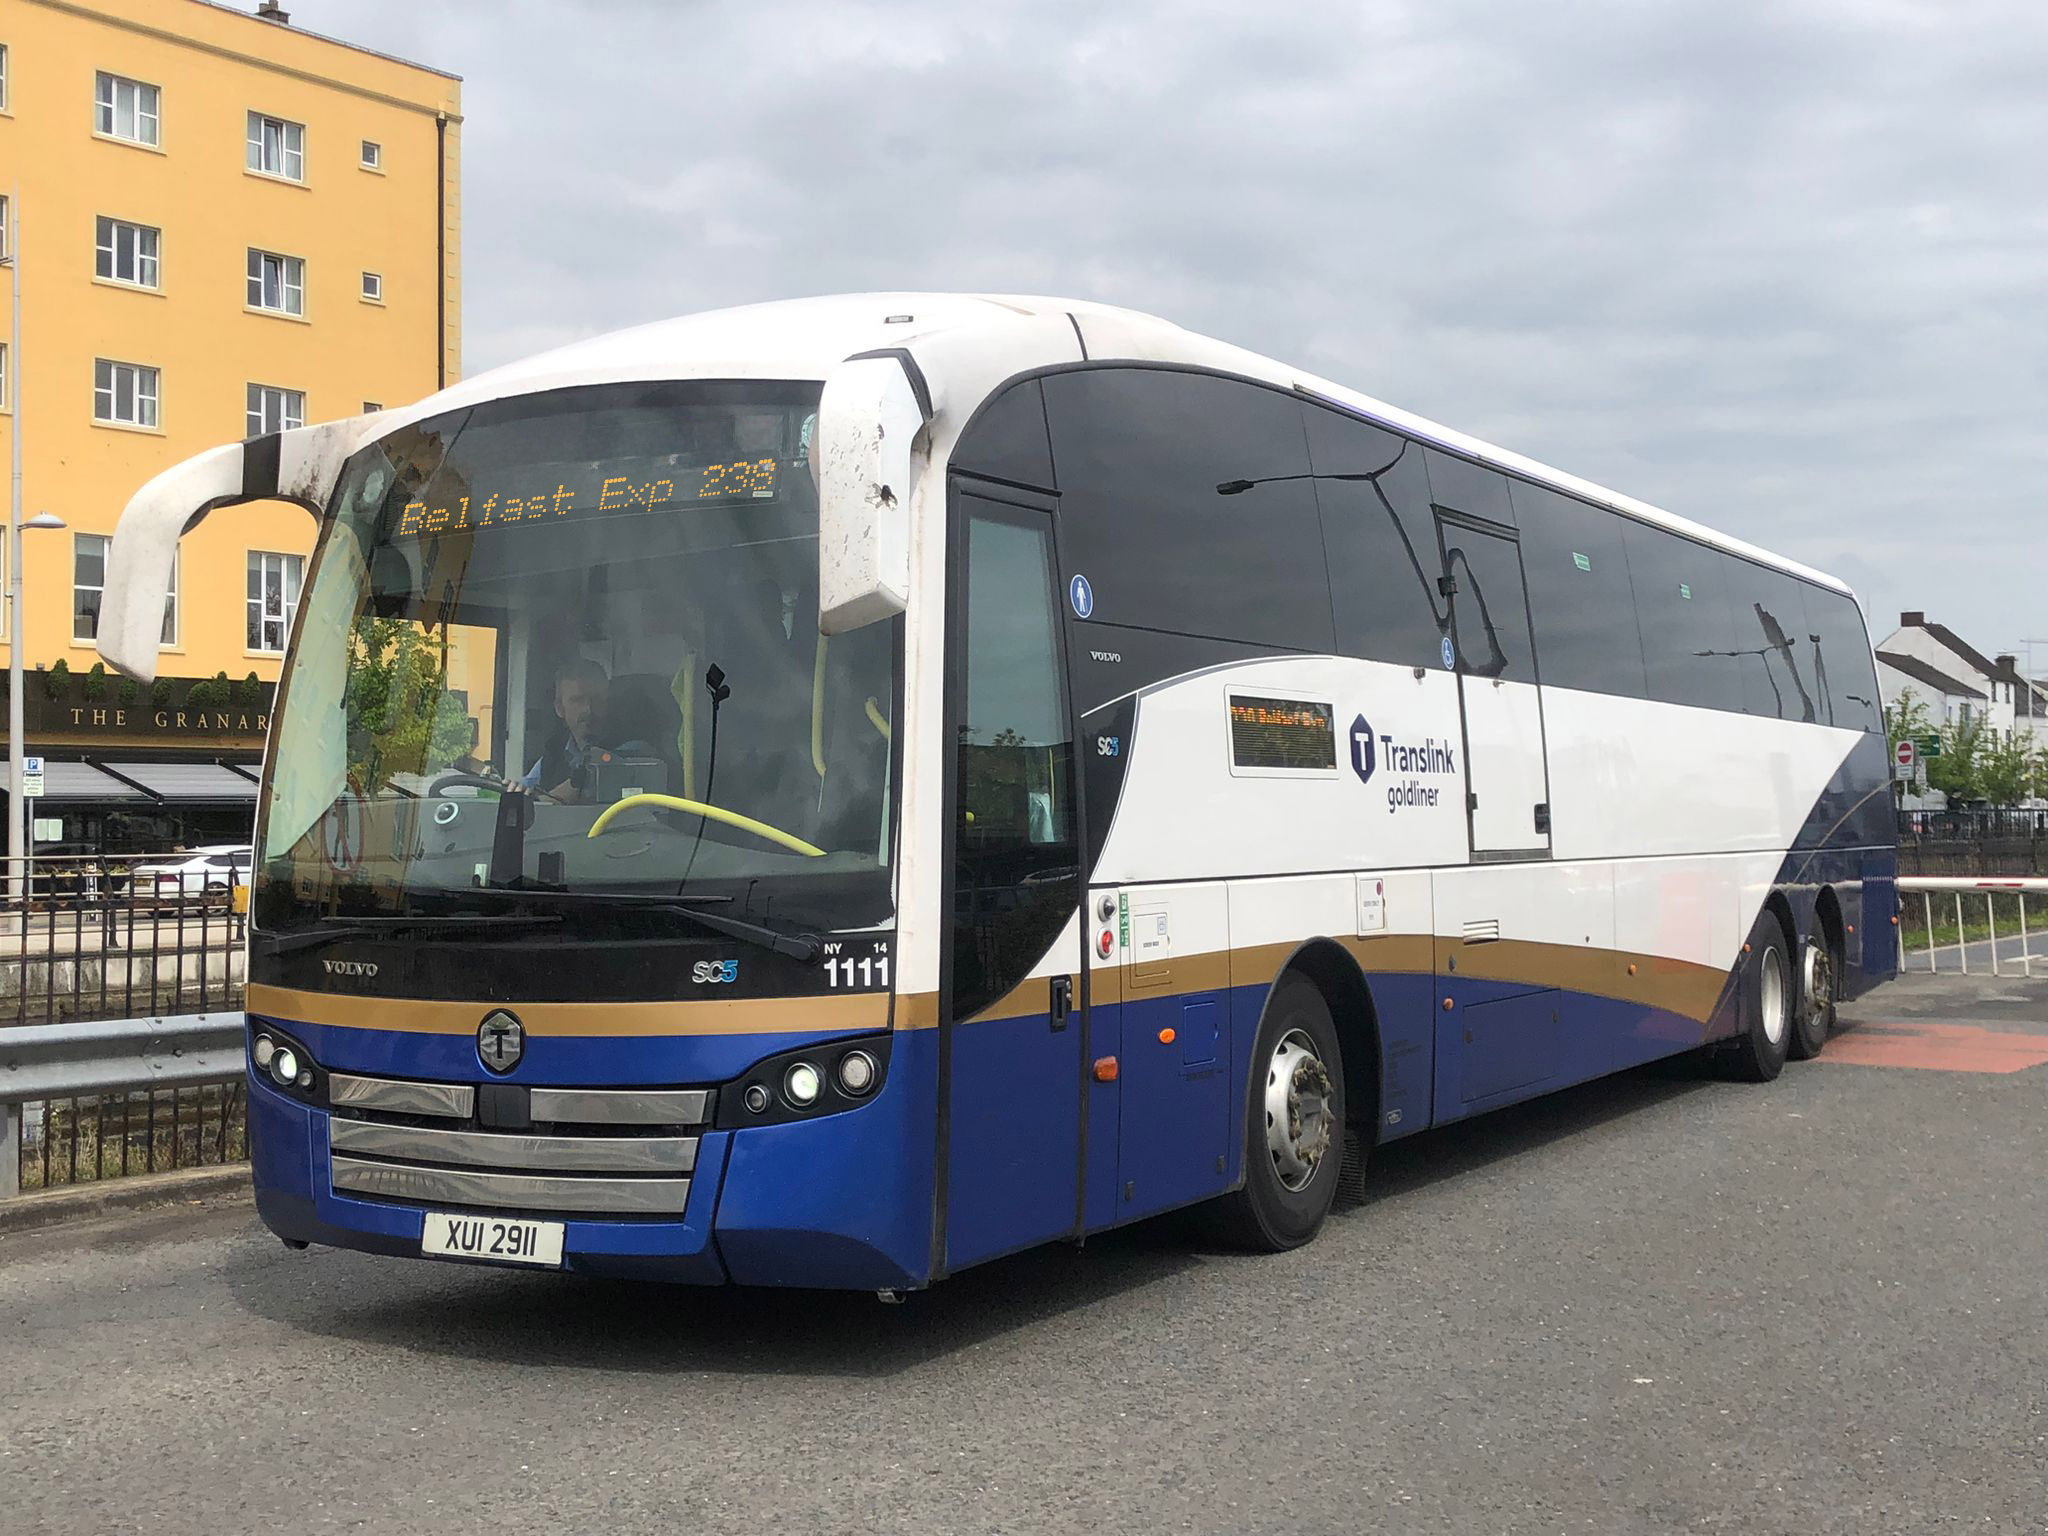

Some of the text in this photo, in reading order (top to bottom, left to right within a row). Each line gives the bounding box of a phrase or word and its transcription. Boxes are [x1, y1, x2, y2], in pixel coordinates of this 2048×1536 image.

[400, 458, 776, 535] Belfast Exp 238
[1089, 650, 1121, 663] VOLVO
[70, 707, 127, 726] THE
[1097, 736, 1120, 756] SC5
[1380, 735, 1456, 774] Translink
[1388, 780, 1439, 814] goldliner
[824, 943, 842, 955] NY
[873, 943, 888, 953] 14
[322, 959, 379, 977] VOLVO
[692, 959, 739, 983] SC5
[823, 957, 889, 987] 1111
[445, 1220, 484, 1252] XUI
